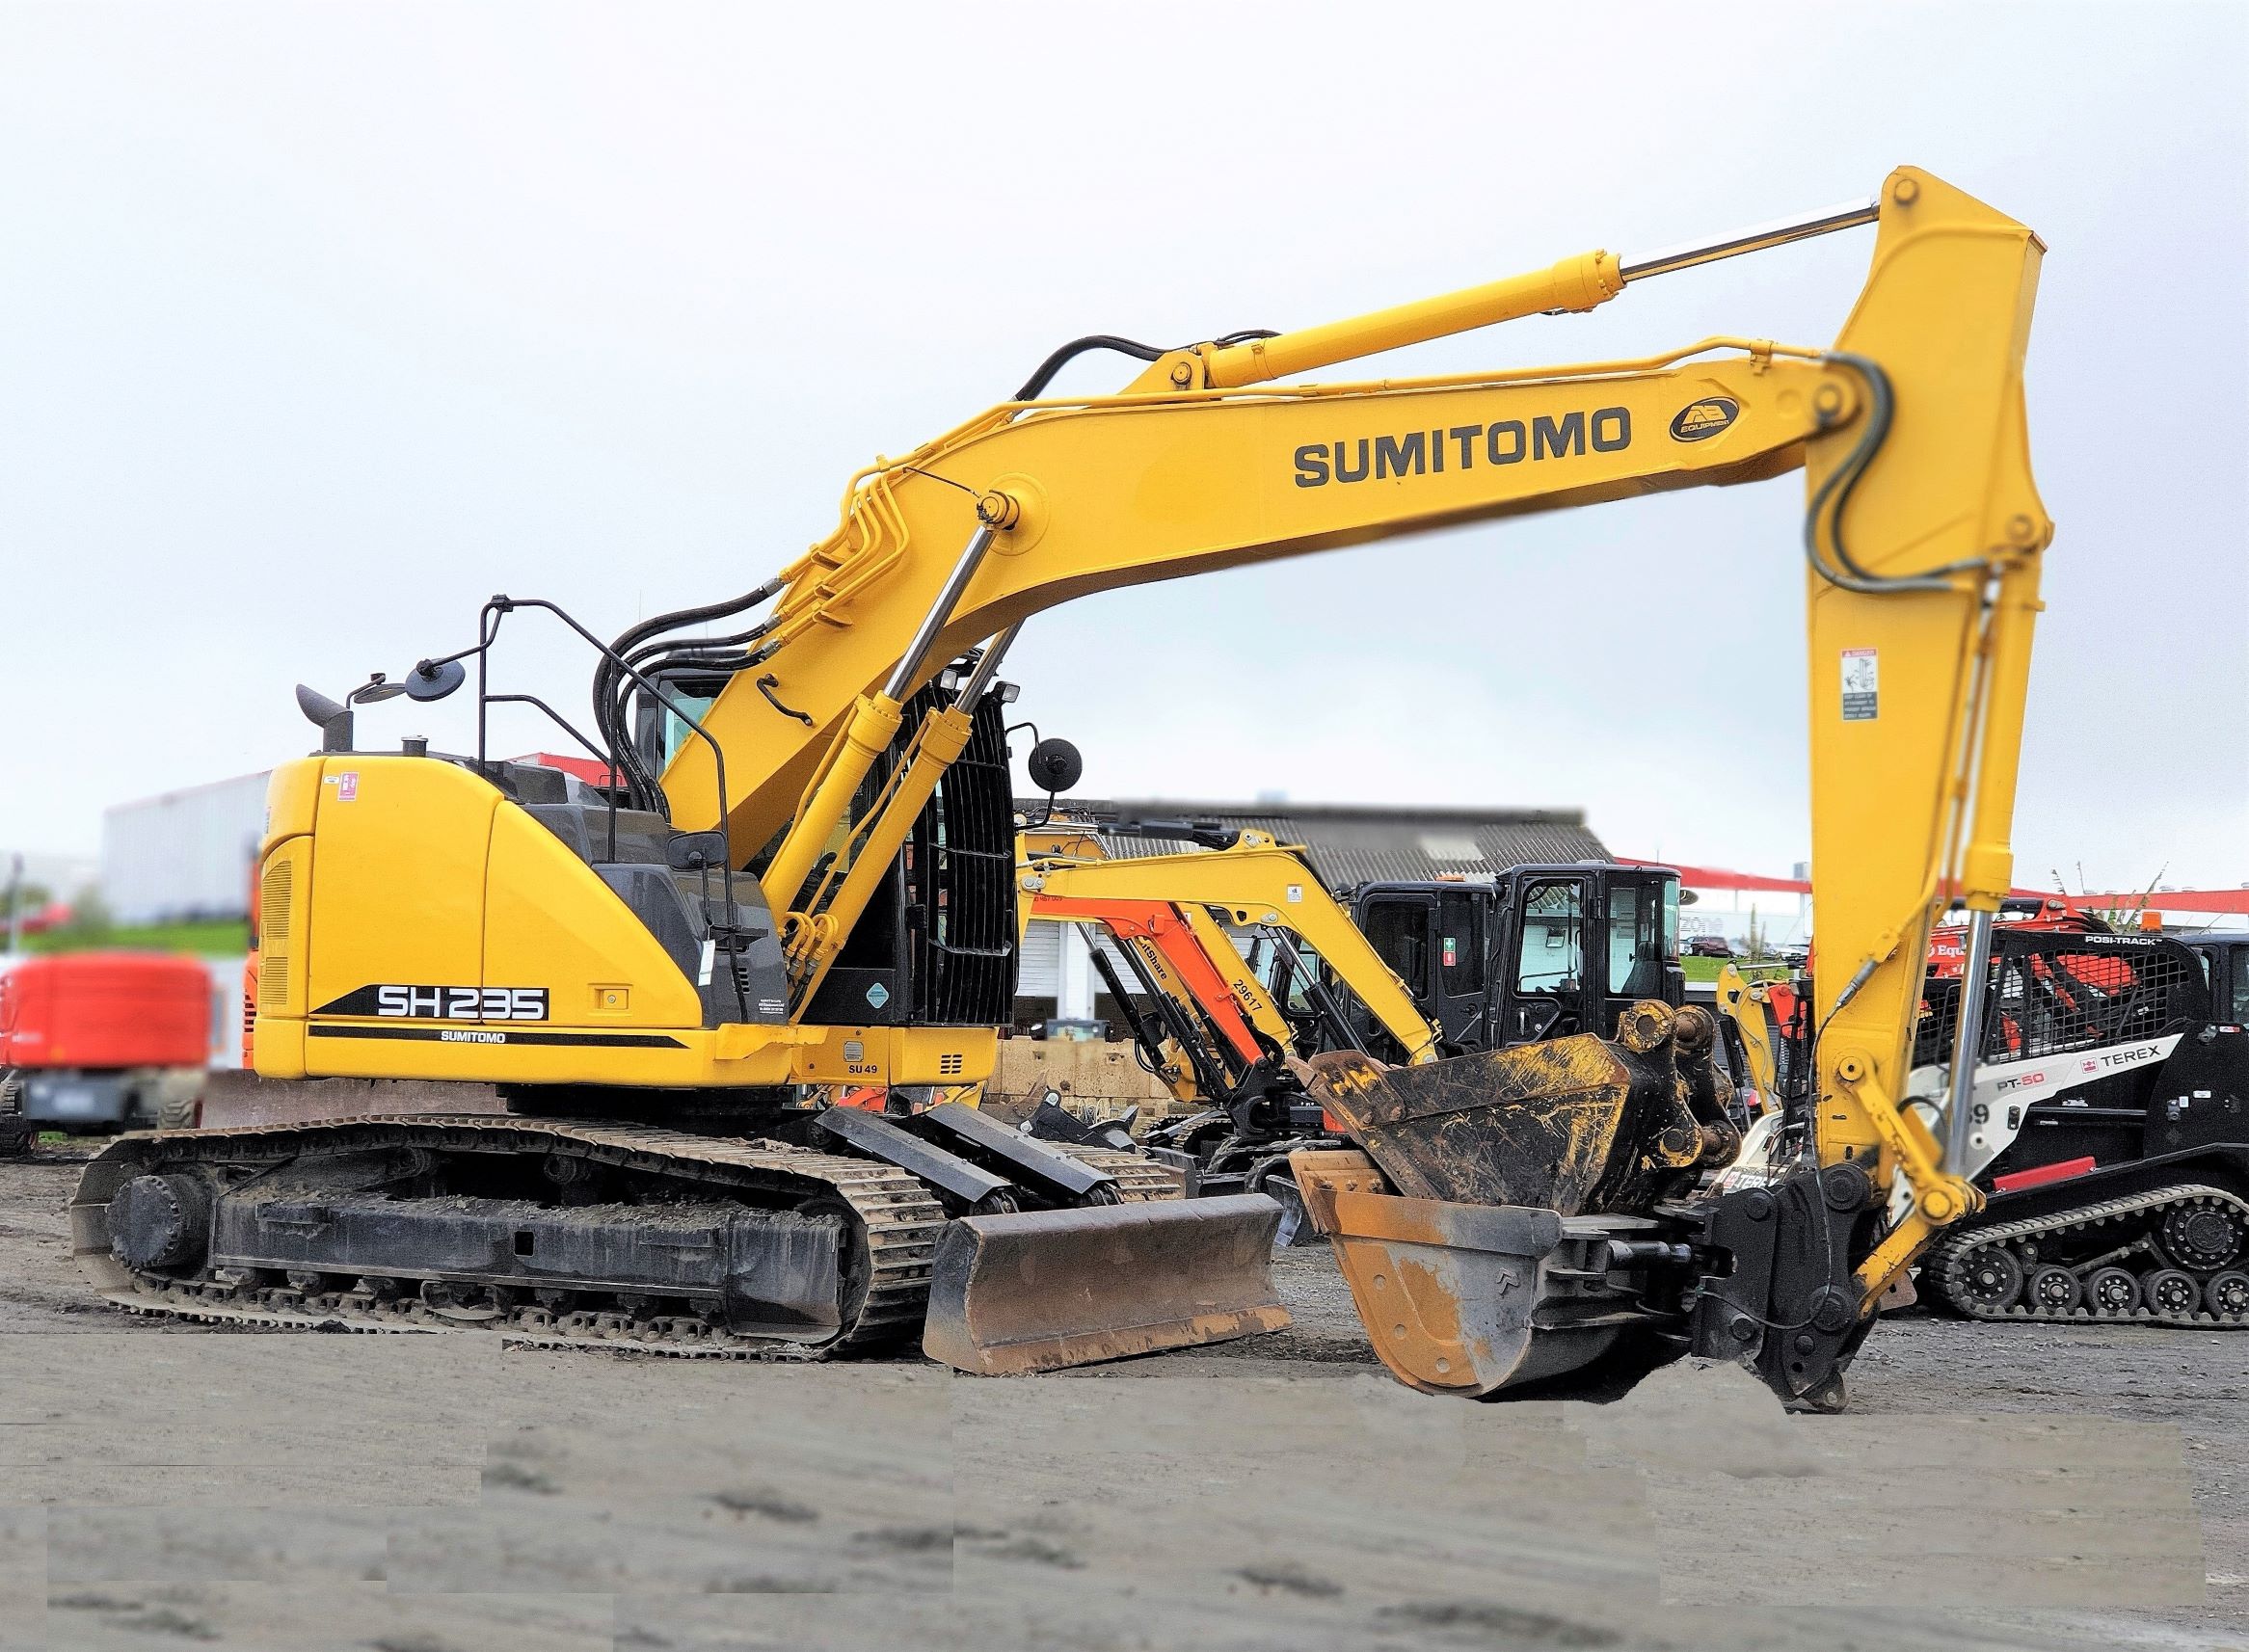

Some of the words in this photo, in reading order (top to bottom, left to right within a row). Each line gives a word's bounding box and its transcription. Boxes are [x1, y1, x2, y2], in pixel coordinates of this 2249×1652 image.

[1680, 419, 1729, 435] EQUIPMENT
[1294, 406, 1632, 489] SUMITOMO
[1233, 979, 1263, 1012] 29617
[441, 1030, 506, 1044] SUMITOMO
[2100, 1045, 2161, 1068] TEREX
[848, 1064, 863, 1074] SU
[864, 1064, 878, 1074] 49
[1997, 1072, 2046, 1092] PT-50
[1968, 1103, 1991, 1126] 9
